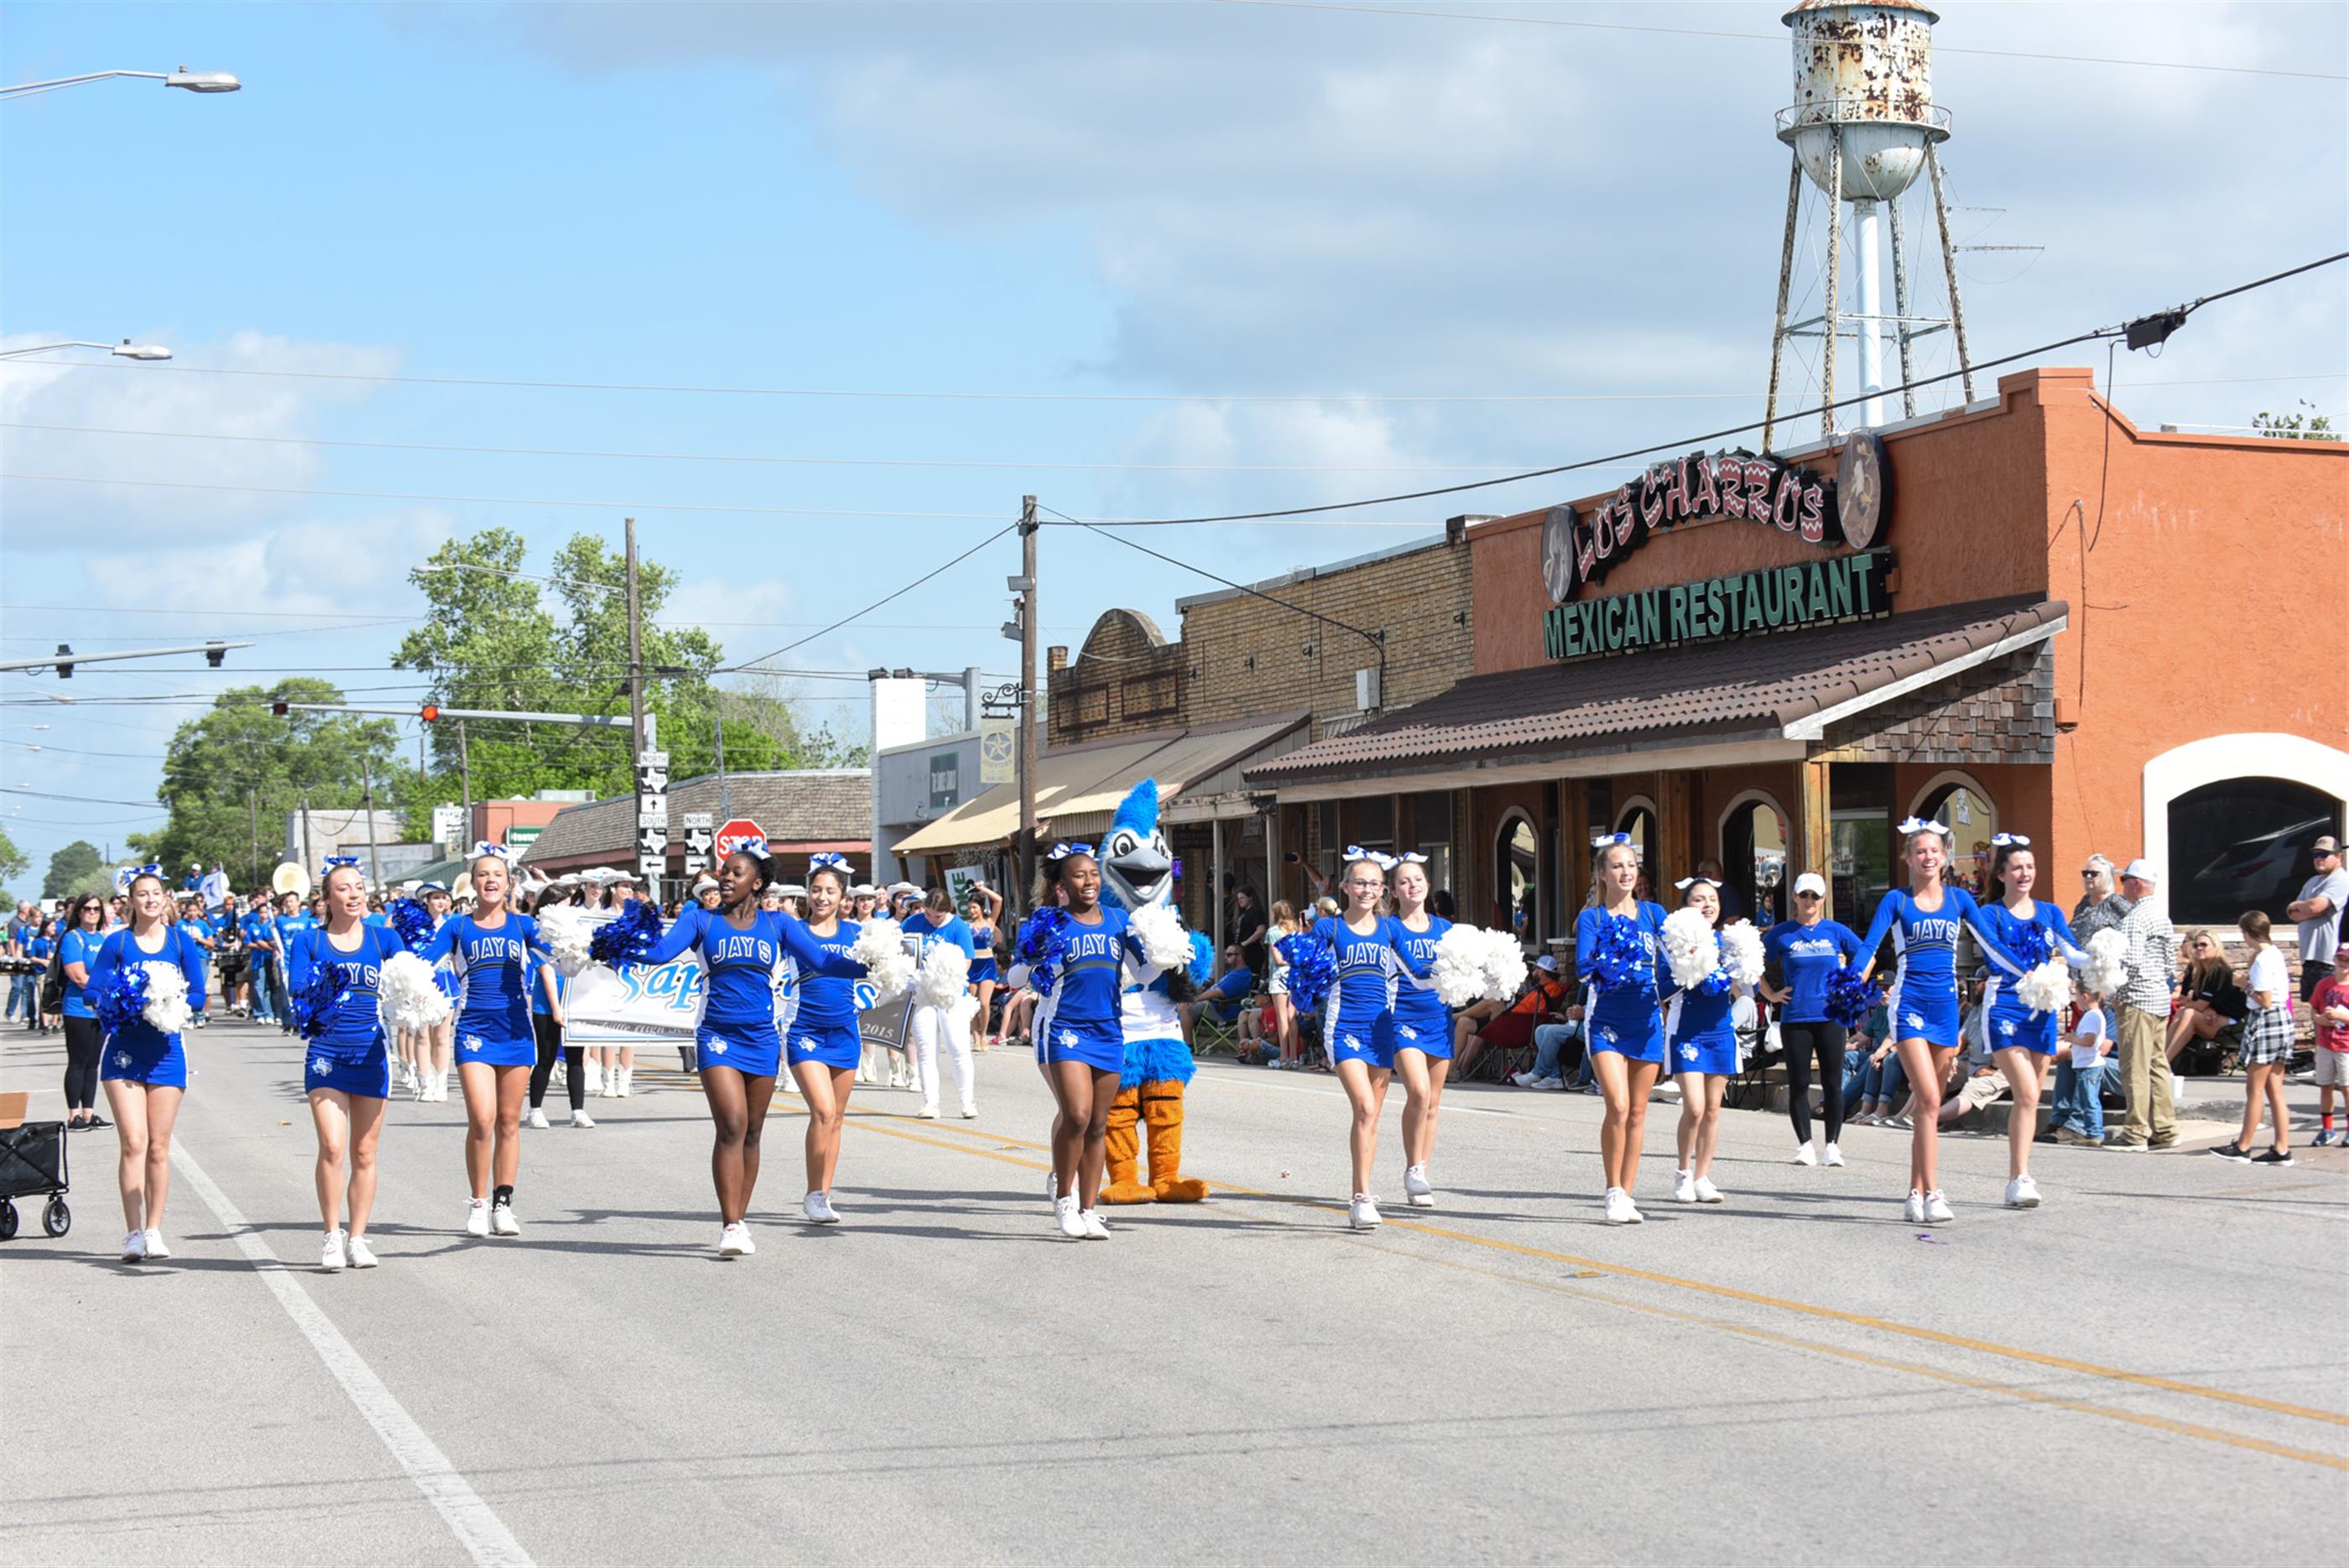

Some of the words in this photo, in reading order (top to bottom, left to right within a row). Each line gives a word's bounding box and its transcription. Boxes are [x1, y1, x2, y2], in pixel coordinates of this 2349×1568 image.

[1573, 484, 1635, 583] LOS
[1640, 456, 1825, 544] CHARROS
[1542, 590, 1661, 659] MEXICAN
[1669, 553, 1873, 641] RESTAURANT
[642, 754, 667, 763] NORTH
[642, 815, 666, 826] SOUTH
[685, 816, 711, 825] NORTH
[1906, 918, 1958, 944] JAYS
[468, 937, 522, 965] JAYS
[712, 935, 773, 965] JAYS
[1067, 933, 1122, 963] JAYS
[1339, 941, 1391, 969] JAYS
[862, 1023, 895, 1039] 2015
